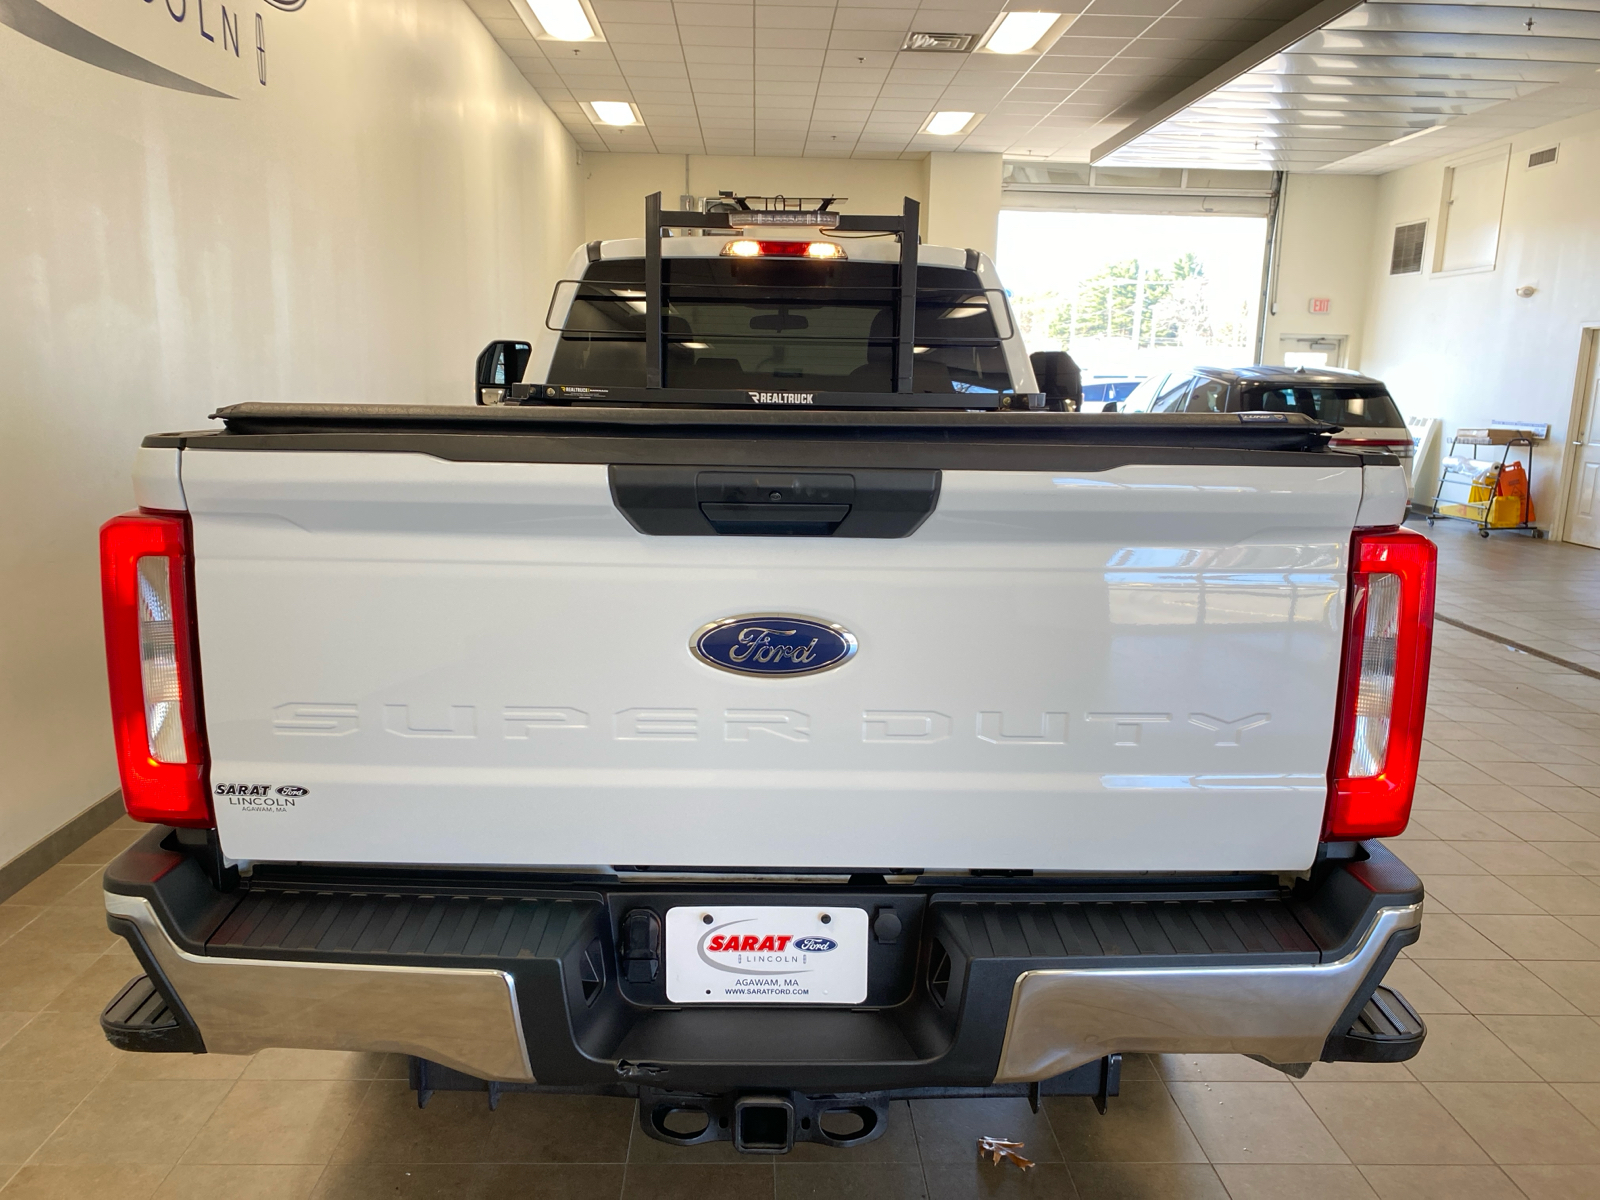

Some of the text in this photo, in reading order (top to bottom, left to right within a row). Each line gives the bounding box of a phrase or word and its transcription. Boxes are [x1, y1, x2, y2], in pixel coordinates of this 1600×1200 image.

[1313, 298, 1330, 312] EXIT
[760, 393, 814, 404] REALTRUCK
[729, 627, 819, 664] Ford
[272, 702, 1272, 747] SUPER DUTY
[214, 783, 272, 797] SARAT
[229, 797, 295, 806] LINCOLN
[707, 934, 794, 953] SARAT
[746, 955, 798, 963] LINCOLN
[735, 979, 799, 987] AGAWAM, MA
